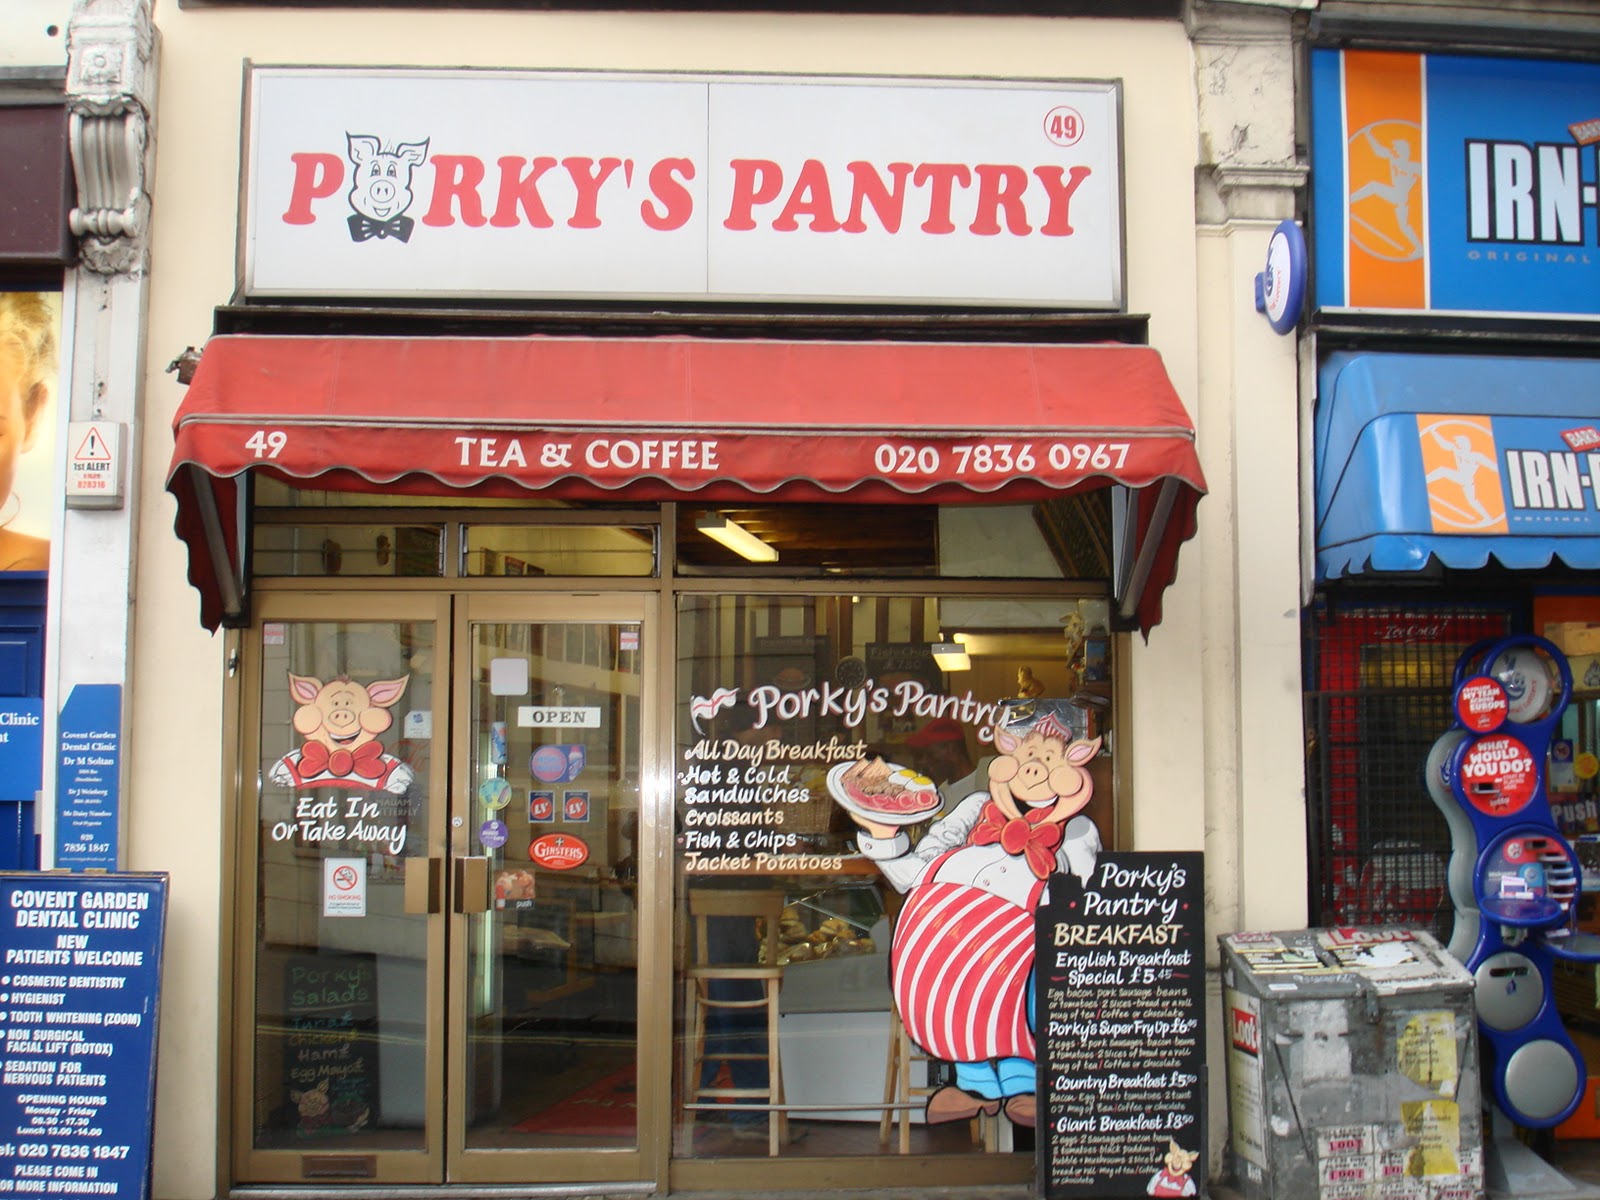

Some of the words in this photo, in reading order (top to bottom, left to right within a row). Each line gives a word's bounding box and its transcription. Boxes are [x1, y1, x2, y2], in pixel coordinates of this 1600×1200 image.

[1049, 114, 1079, 140] 49
[282, 145, 697, 236] PRKY'S
[723, 158, 1092, 237] PANTRY
[1466, 140, 1600, 245] IRN-
[1468, 250, 1591, 264] ORIGINAL
[244, 430, 288, 459] 49
[455, 436, 528, 468] TEA
[540, 443, 573, 467] &
[584, 439, 720, 471] COFFEE
[874, 443, 940, 475] 020
[951, 443, 1036, 475] 7836
[1048, 442, 1131, 471] 0967
[73, 462, 85, 471] 1st
[86, 462, 111, 471] ALERT
[532, 710, 587, 724] OPEN
[747, 679, 888, 730] Porky's
[893, 679, 1011, 744] Pantry
[62, 742, 90, 751] Dental
[91, 742, 117, 751] Clinic
[684, 740, 720, 761] All
[721, 739, 764, 766] Day
[765, 736, 868, 761] Breakfast
[1477, 740, 1509, 751] WHAT
[63, 757, 75, 765] Dr
[1469, 747, 1519, 764] WOULD
[682, 765, 722, 785] Hot
[725, 769, 740, 785] &
[744, 765, 790, 785] Cold
[1463, 761, 1498, 777] YOU
[1499, 758, 1532, 774] DO?
[684, 784, 810, 805] Sandwiches
[296, 796, 338, 819] Eat
[344, 796, 381, 819] In
[684, 808, 784, 827] Croissants
[271, 821, 299, 842] Or
[299, 820, 345, 841] Take
[346, 820, 407, 855] Away
[684, 830, 720, 850] Fish
[725, 832, 741, 849] &
[744, 829, 797, 854] Chips
[533, 841, 584, 860] GINSTERS
[685, 852, 752, 872] Jacket
[753, 852, 843, 872] Potatoes
[1100, 862, 1187, 896] Porky's
[10, 890, 78, 908] COVENT
[81, 891, 149, 910] GARDEN
[1083, 891, 1179, 924] Pantry
[16, 910, 79, 928] DENTAL
[83, 911, 140, 929] CLINIC
[56, 935, 90, 949] NEW
[1053, 922, 1184, 947] BREAKFAST
[6, 949, 71, 965] PATIENTS
[73, 951, 143, 967] WELCOME
[1055, 950, 1116, 972] English
[1118, 948, 1192, 967] Breakfast
[12, 975, 67, 988] COSMETIC
[68, 976, 127, 989] DENTISTRY
[1068, 967, 1124, 988] Special
[10, 992, 66, 1005] HYGIENIST
[1066, 986, 1093, 999] bacon
[1096, 987, 1117, 999] pork
[1155, 985, 1188, 998] beans
[10, 1011, 43, 1023] TOOTH
[46, 1012, 103, 1025] WHITENING
[104, 1013, 141, 1028] (ZOOM)
[1050, 1011, 1068, 1023] mug
[1070, 1008, 1080, 1021] of
[7, 1029, 31, 1041] NON
[33, 1029, 85, 1042] SURGICAL
[1048, 1018, 1098, 1041] Porky's
[1099, 1019, 1135, 1038] Super
[1134, 1020, 1156, 1038] Fry
[1155, 1020, 1170, 1038] Up
[6, 1041, 44, 1053] FACIAL
[45, 1042, 69, 1054] LIFT
[70, 1042, 114, 1057] (BOTOX)
[1055, 1041, 1076, 1052] eggs
[5, 1060, 57, 1073] SEDATION
[60, 1061, 82, 1074] FOR
[1051, 1061, 1070, 1074] mug
[1071, 1059, 1082, 1071] of
[3, 1073, 53, 1086] NERVOUS
[56, 1074, 107, 1087] PATIENTS
[1055, 1074, 1107, 1094] Country
[1108, 1071, 1168, 1089] Breakfast
[17, 1094, 67, 1105] OPENING
[68, 1095, 108, 1105] HOURS
[24, 1106, 61, 1116] Monday
[67, 1107, 97, 1117] Friday
[17, 1126, 46, 1136] Lunch
[1056, 1115, 1097, 1133] Giant
[1099, 1112, 1163, 1133] Breakfast
[18, 1143, 49, 1157] 020
[51, 1144, 90, 1158] 7836
[93, 1145, 130, 1159] 1847
[14, 1164, 53, 1177] PLEASE
[54, 1165, 85, 1178] COME
[86, 1166, 98, 1178] IN
[15, 1180, 46, 1192] MORE
[47, 1181, 118, 1194] INFORMATION
